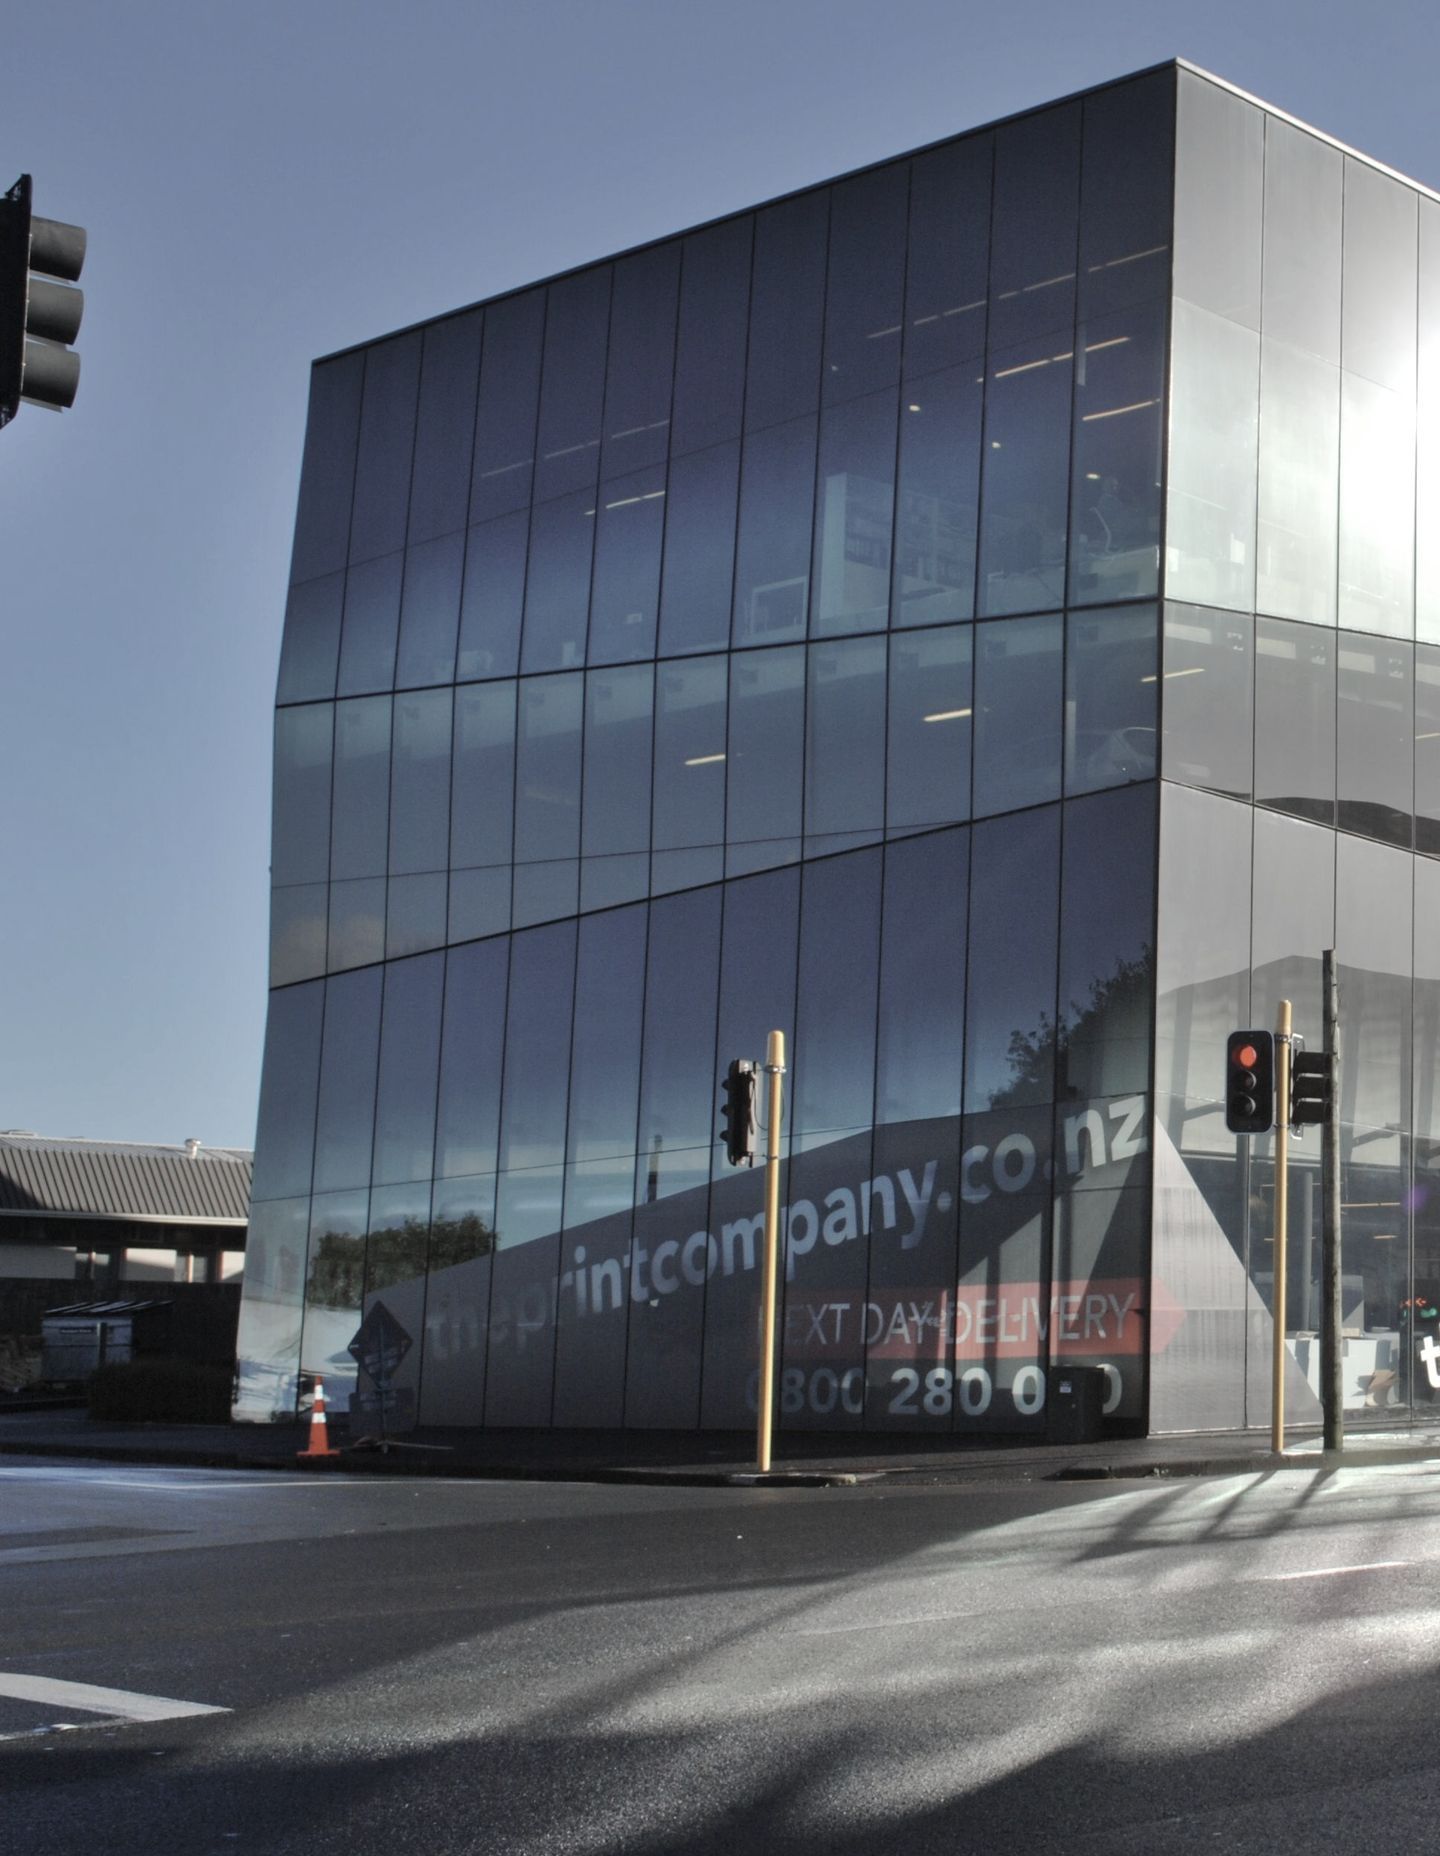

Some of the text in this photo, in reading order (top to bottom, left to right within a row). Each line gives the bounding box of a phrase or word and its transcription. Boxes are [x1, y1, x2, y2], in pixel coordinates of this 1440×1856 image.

[424, 1094, 1148, 1358] thprintcompany.co.nz
[758, 1292, 1137, 1345] EXT DAY DELIVERY
[887, 1367, 992, 1416] 280
[1011, 1363, 1122, 1416] 00
